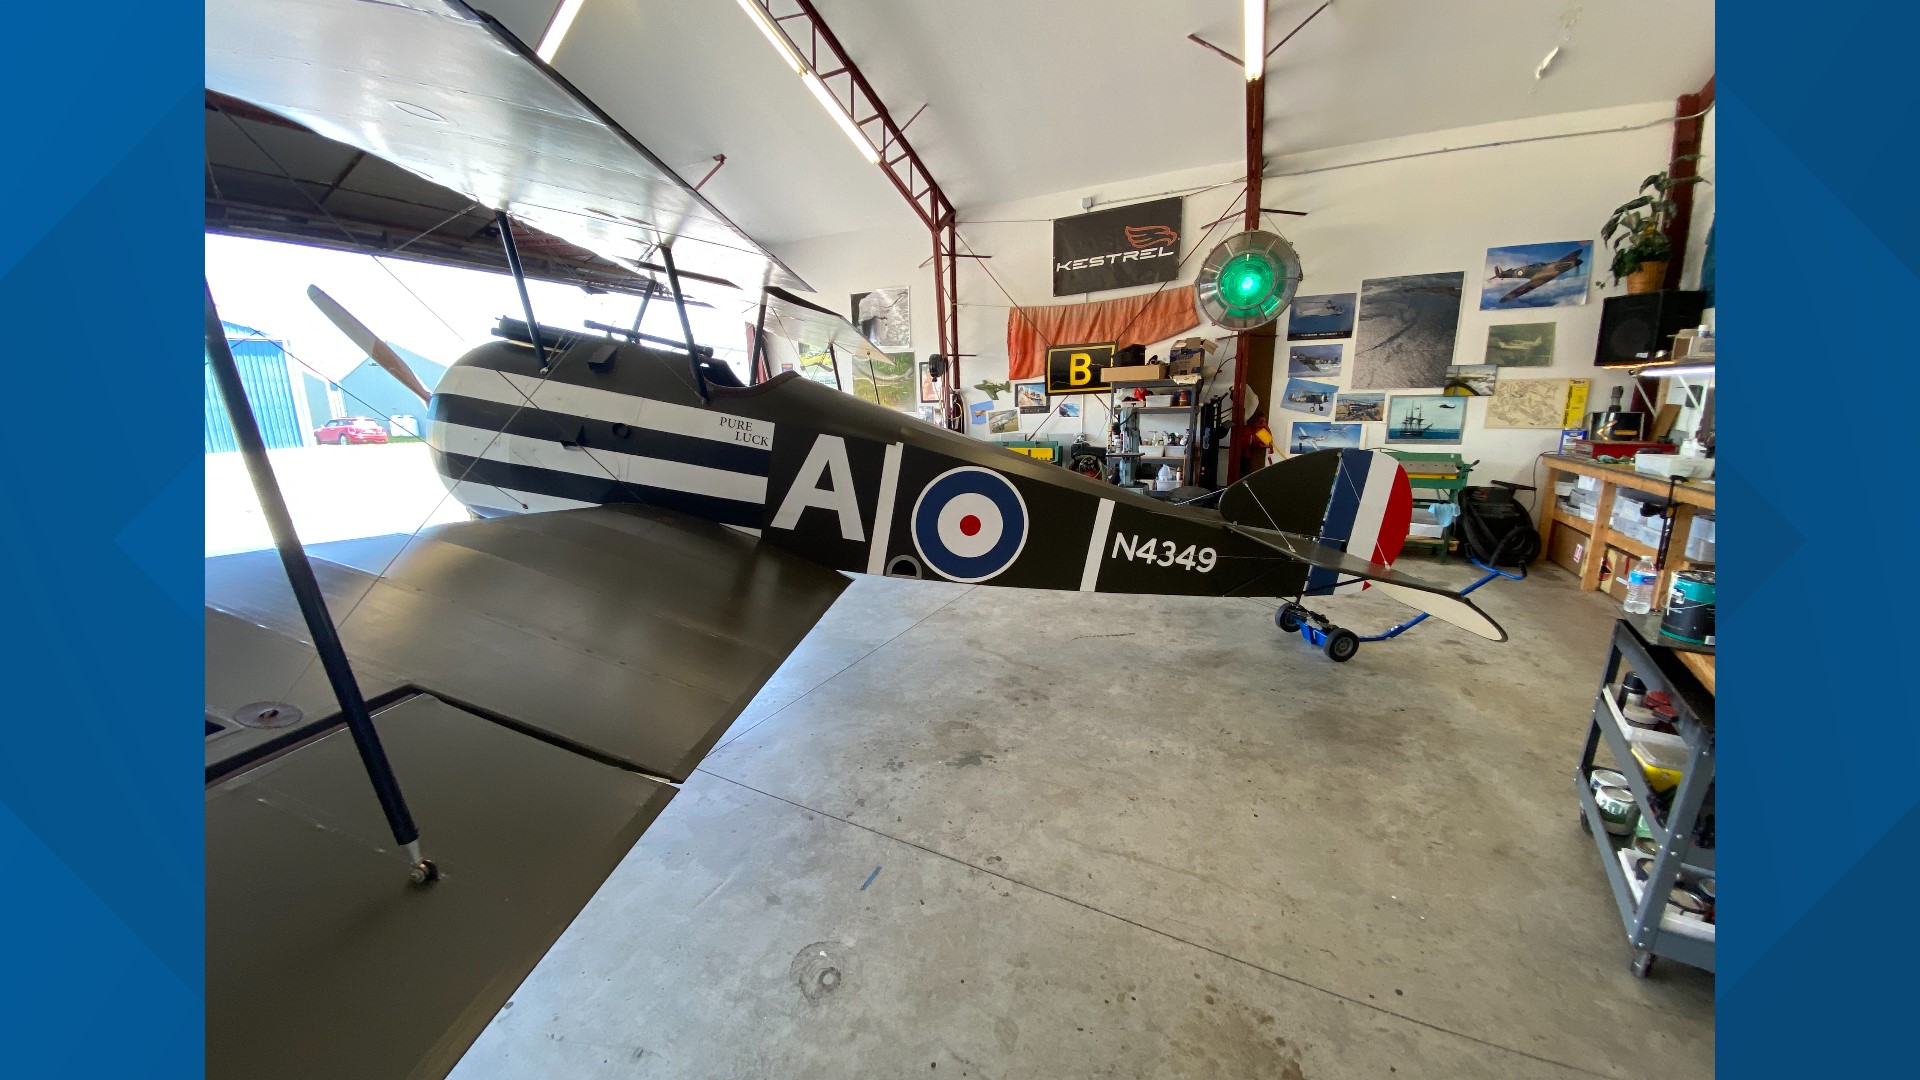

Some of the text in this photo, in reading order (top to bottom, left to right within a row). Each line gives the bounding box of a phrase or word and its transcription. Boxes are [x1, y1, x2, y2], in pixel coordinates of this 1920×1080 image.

[1056, 246, 1175, 272] KESTREL
[1070, 352, 1091, 386] B
[719, 416, 753, 431] PURE
[735, 430, 770, 446] LUCK
[770, 433, 866, 542] A
[1111, 531, 1217, 573] N4349
